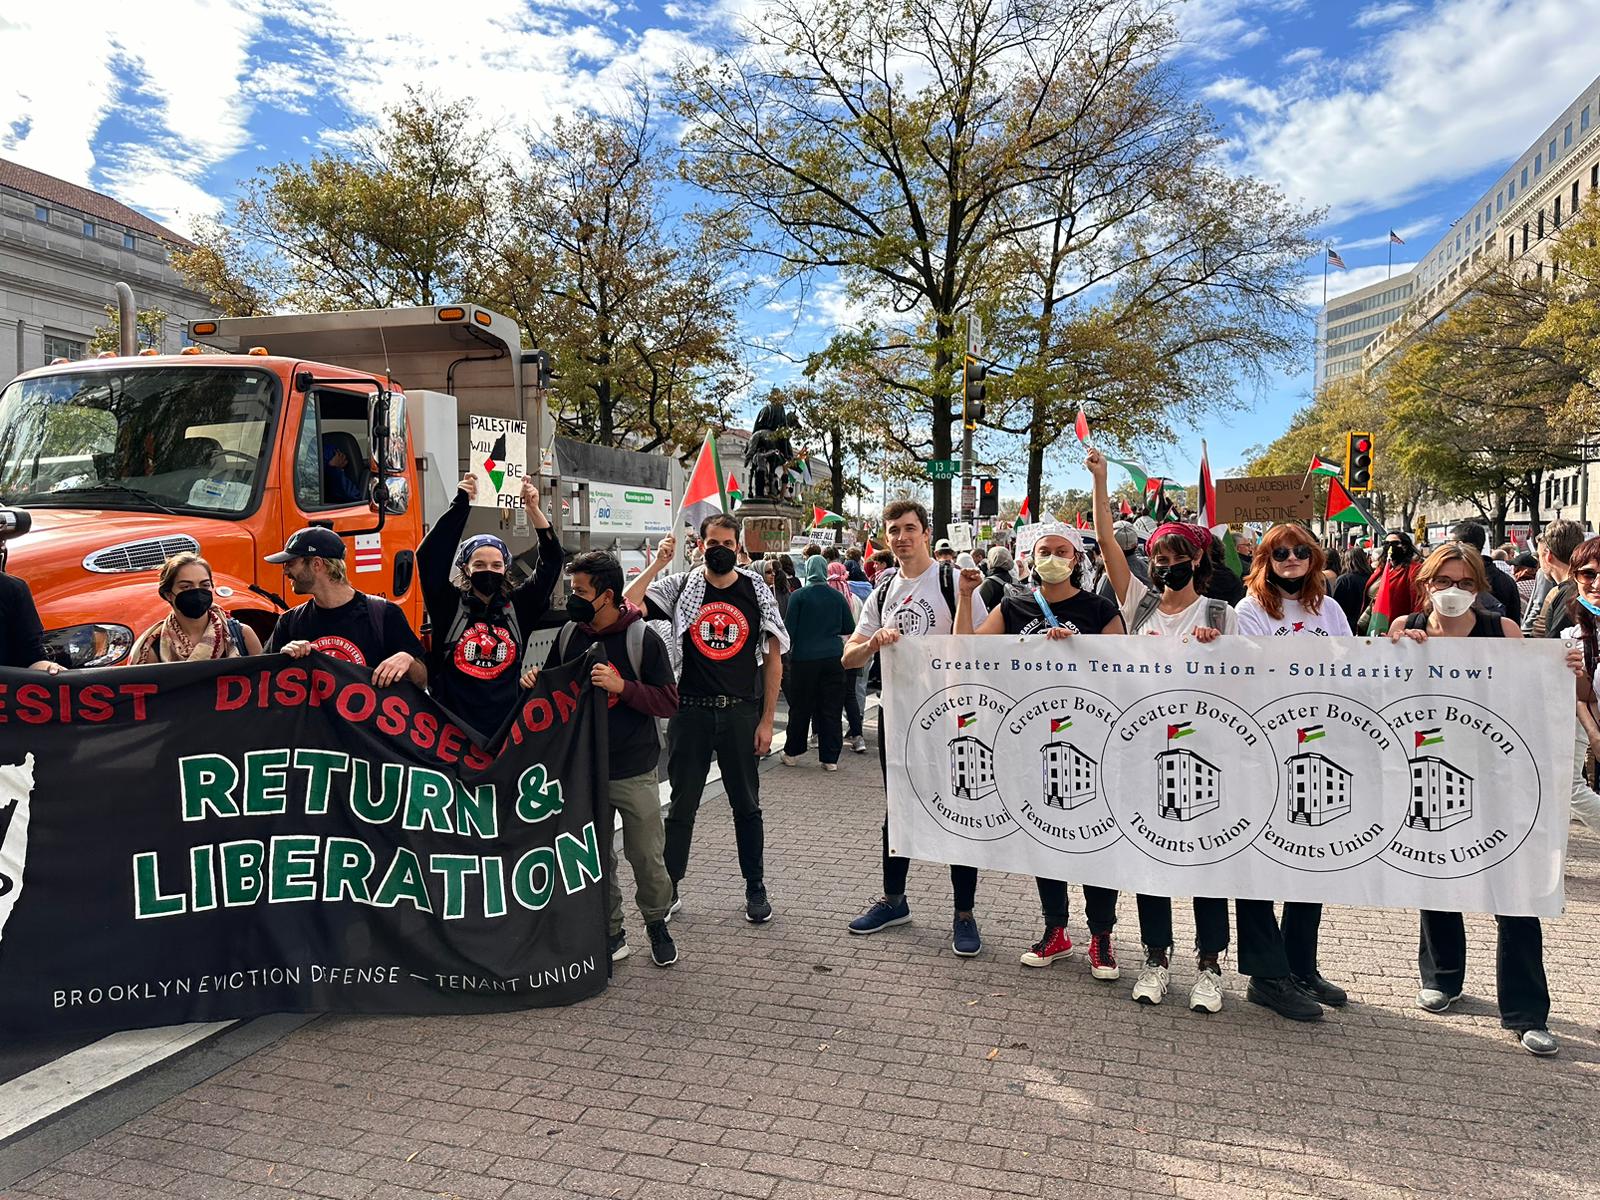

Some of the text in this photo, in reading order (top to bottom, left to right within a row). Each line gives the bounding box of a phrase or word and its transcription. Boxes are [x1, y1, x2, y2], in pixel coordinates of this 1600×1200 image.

[470, 416, 527, 434] PALESTINE
[470, 440, 492, 453] WILL
[507, 463, 522, 478] BE
[935, 462, 944, 472] 13
[497, 494, 526, 509] FREE
[1225, 479, 1301, 493] BANGLADESHIS
[1256, 495, 1272, 504] FOR
[1234, 505, 1297, 521] PALESTINE
[811, 531, 833, 540] FREE ALL
[919, 598, 936, 627] BOSTON
[319, 638, 344, 648] EVICTION
[931, 658, 1000, 671] Greater
[1011, 659, 1078, 672] Boston
[1089, 660, 1173, 674] Tenants
[1186, 662, 1256, 675] Union
[1289, 663, 1414, 681] Solidarity
[1428, 665, 1493, 679] Now!
[920, 695, 973, 731] Greater
[1009, 698, 1068, 735] Greater
[1120, 701, 1259, 747] Greater Boston
[1326, 704, 1393, 751] Boston
[1445, 706, 1516, 756] Boston
[178, 747, 565, 840] RETURN &
[931, 792, 983, 829] Tenants
[1020, 800, 1076, 840] Tenants
[1129, 812, 1252, 853] Tenants Union
[1330, 821, 1385, 857] Union
[1450, 827, 1509, 863] Union
[132, 820, 604, 921] LIBERATION
[54, 977, 191, 1008] BROOKLYN
[198, 966, 300, 993] EVICTION
[434, 973, 520, 992] TENANT
[529, 955, 596, 989] UNION
